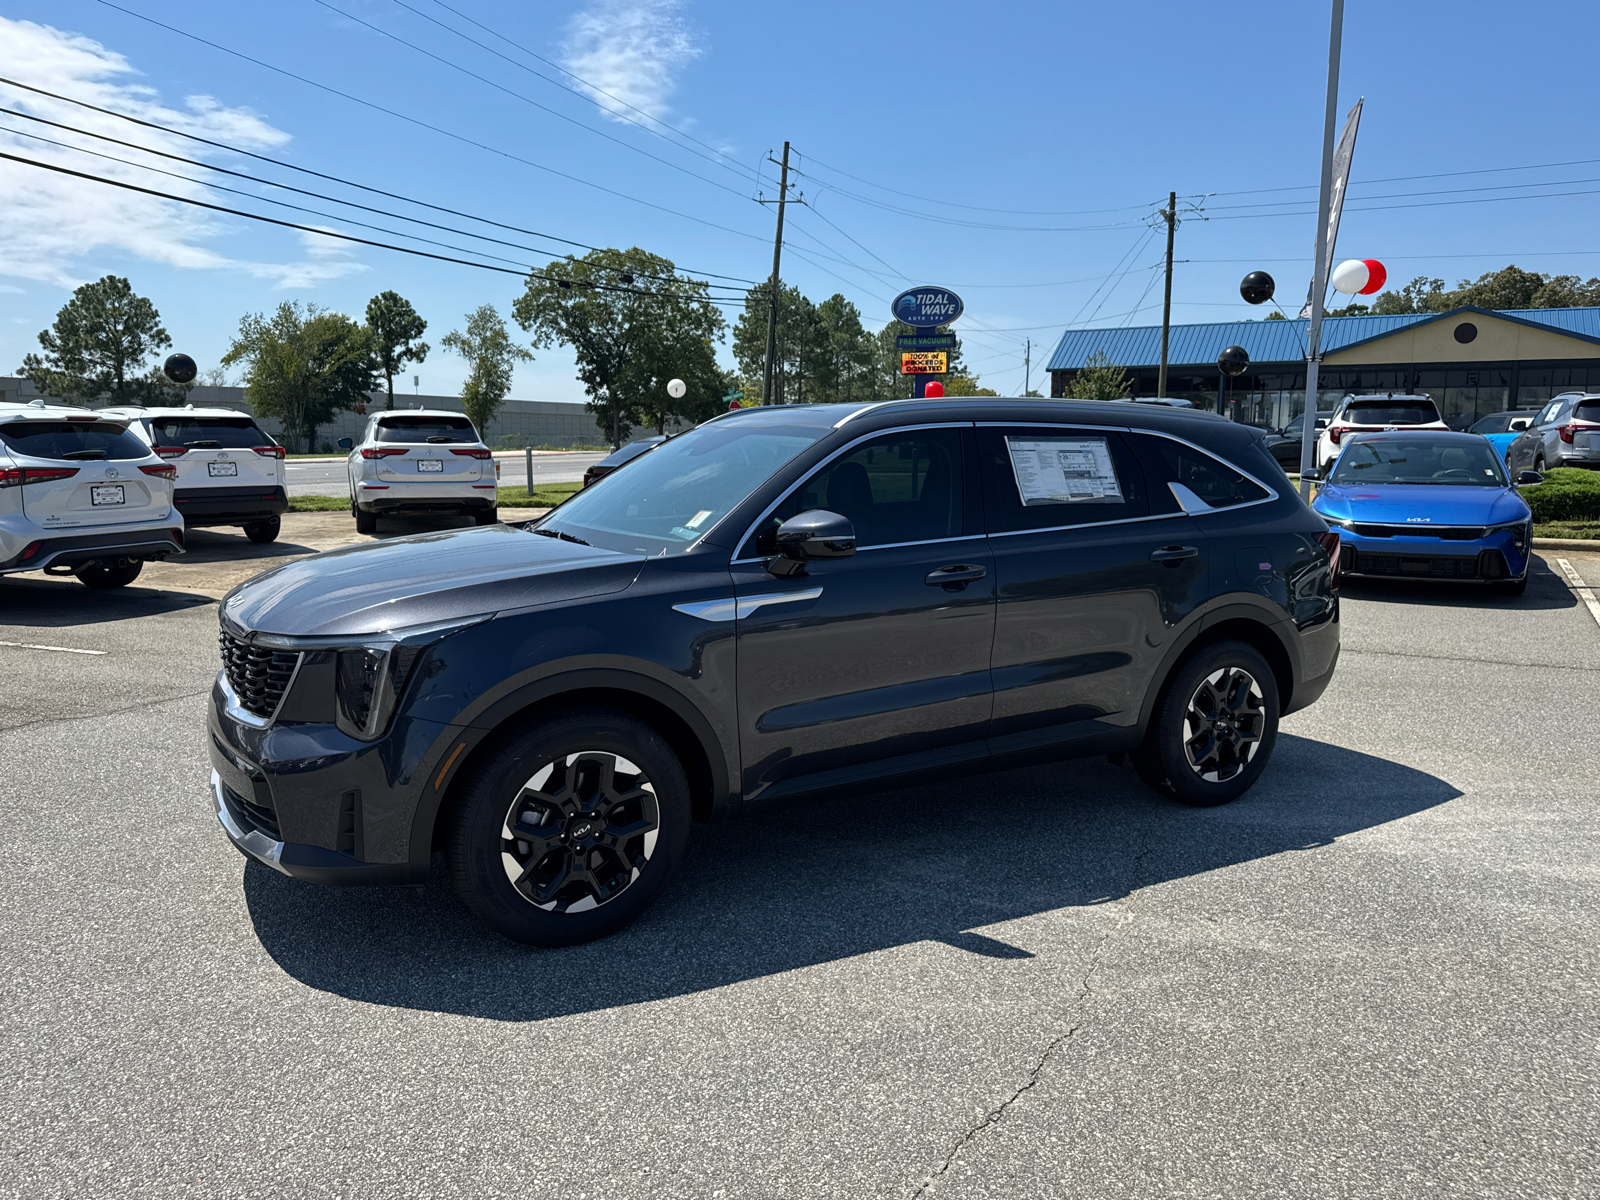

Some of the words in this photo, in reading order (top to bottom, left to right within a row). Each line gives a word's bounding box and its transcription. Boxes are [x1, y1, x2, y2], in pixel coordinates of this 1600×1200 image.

[916, 294, 949, 304] TIDAL
[921, 304, 956, 315] WAVE
[918, 337, 951, 345] VACUUMS
[573, 824, 591, 837] KIA
